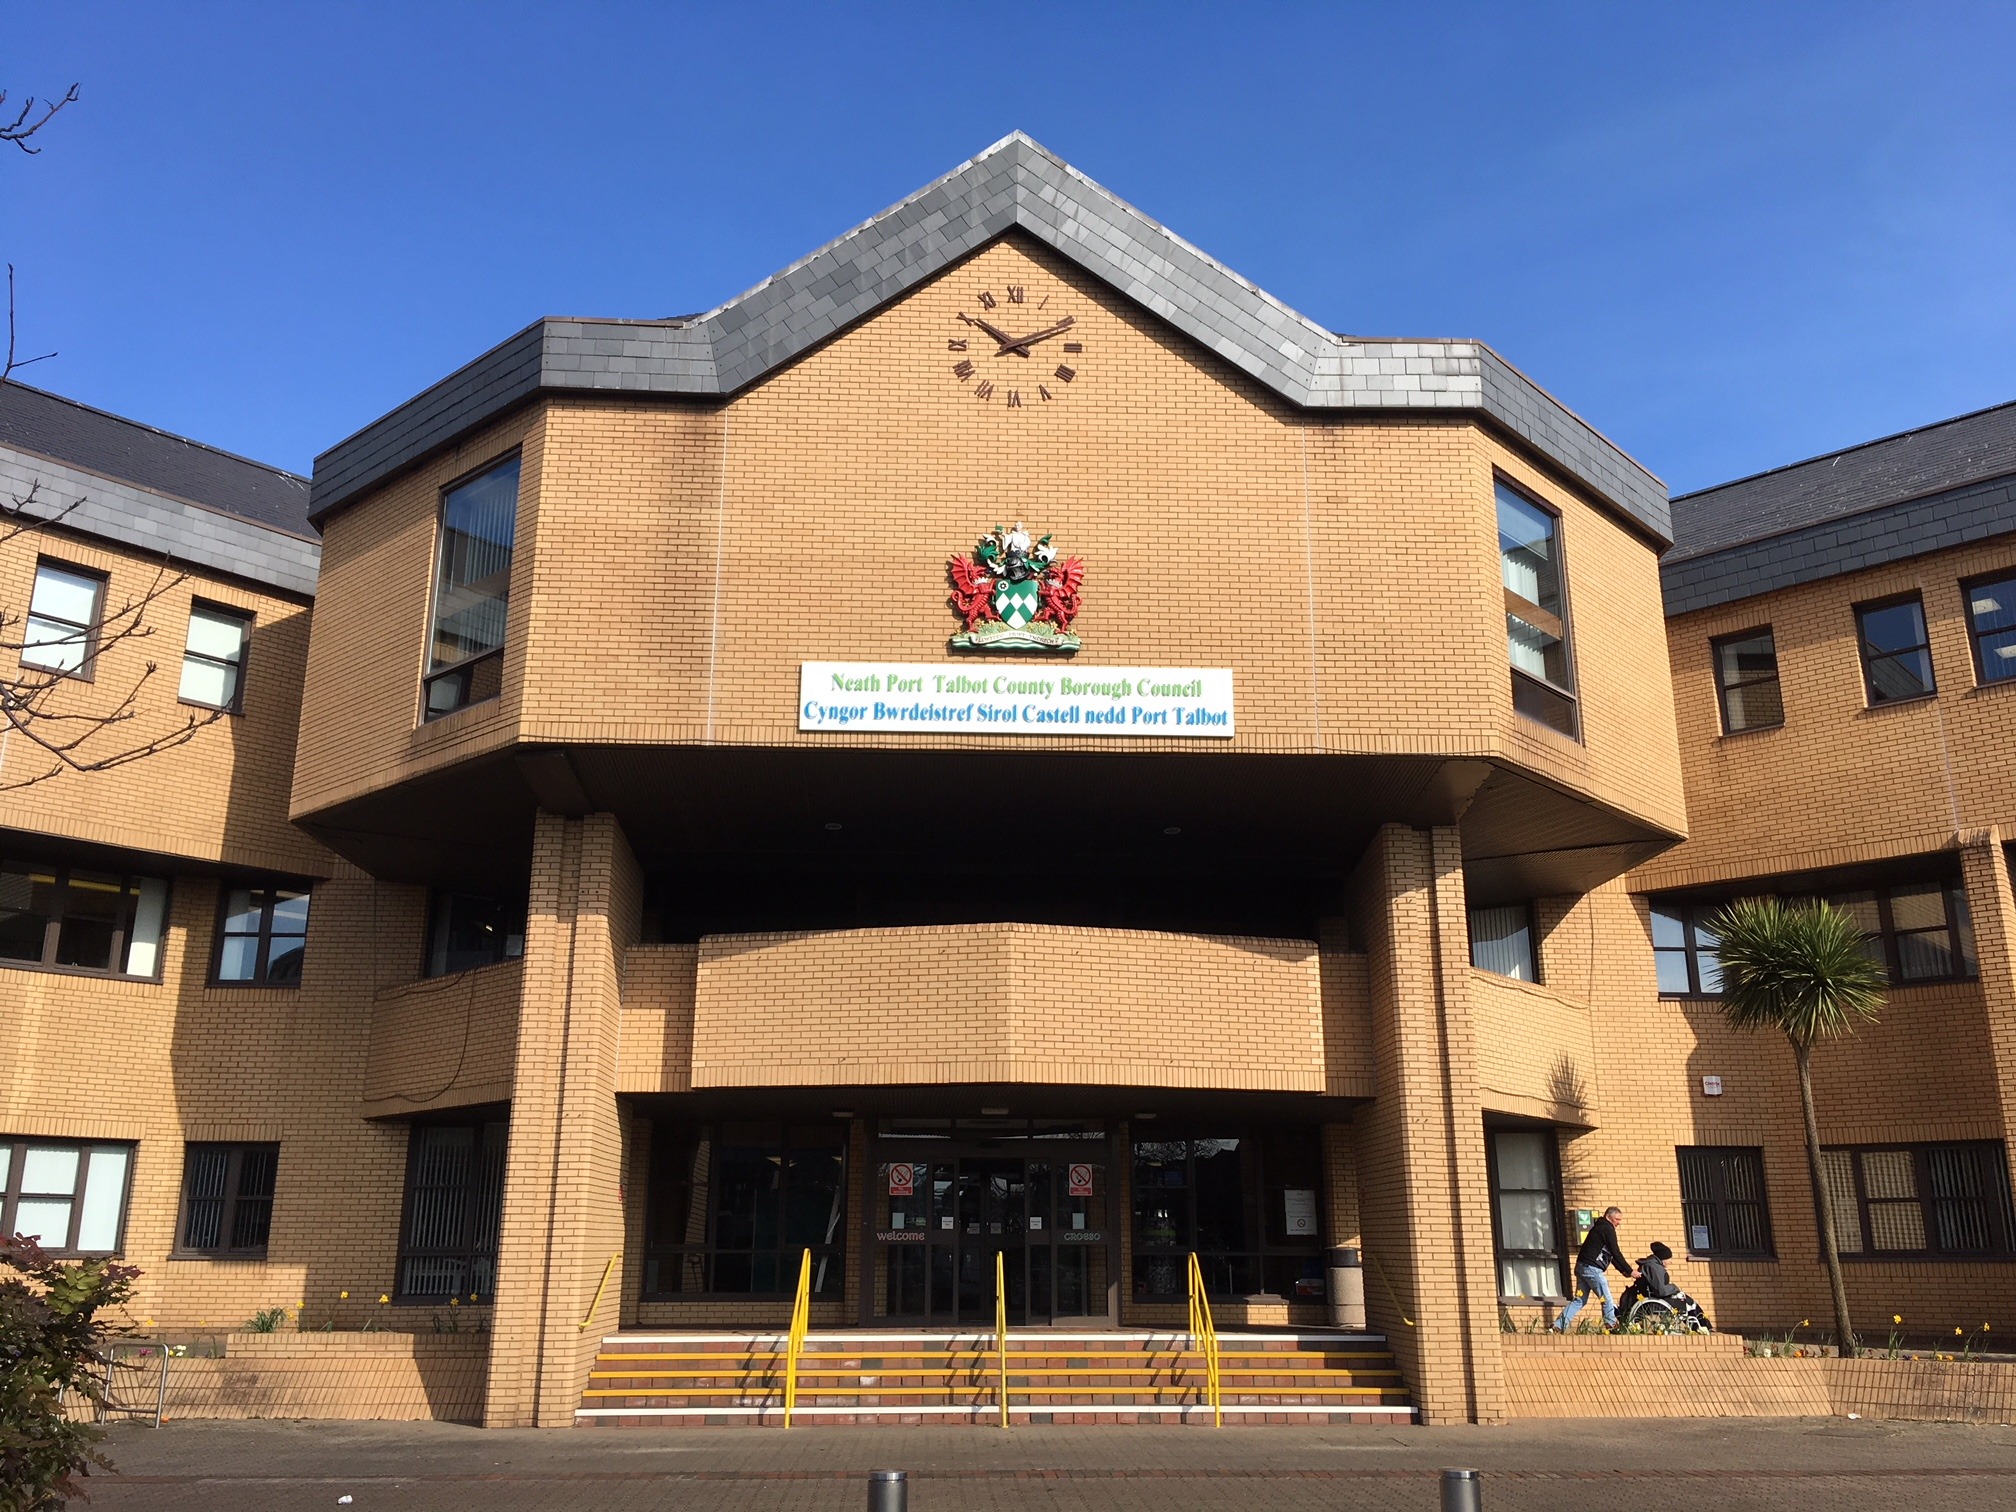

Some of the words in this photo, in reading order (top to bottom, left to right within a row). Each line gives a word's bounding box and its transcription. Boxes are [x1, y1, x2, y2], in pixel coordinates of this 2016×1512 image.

[831, 673, 881, 692] Neath
[887, 674, 923, 693] Port
[933, 674, 988, 694] Talbot
[993, 676, 1055, 700] County
[1060, 677, 1132, 701] Borough
[1137, 678, 1202, 697] Council
[804, 700, 868, 725] Cyngor
[873, 702, 974, 722] Bwrdeistref
[976, 703, 1017, 722] Sirol
[1022, 704, 1080, 723] Castell
[1085, 706, 1126, 724] nedd
[1131, 706, 1167, 725] Port
[1172, 707, 1228, 726] Talbot
[876, 1230, 925, 1241] welcome
